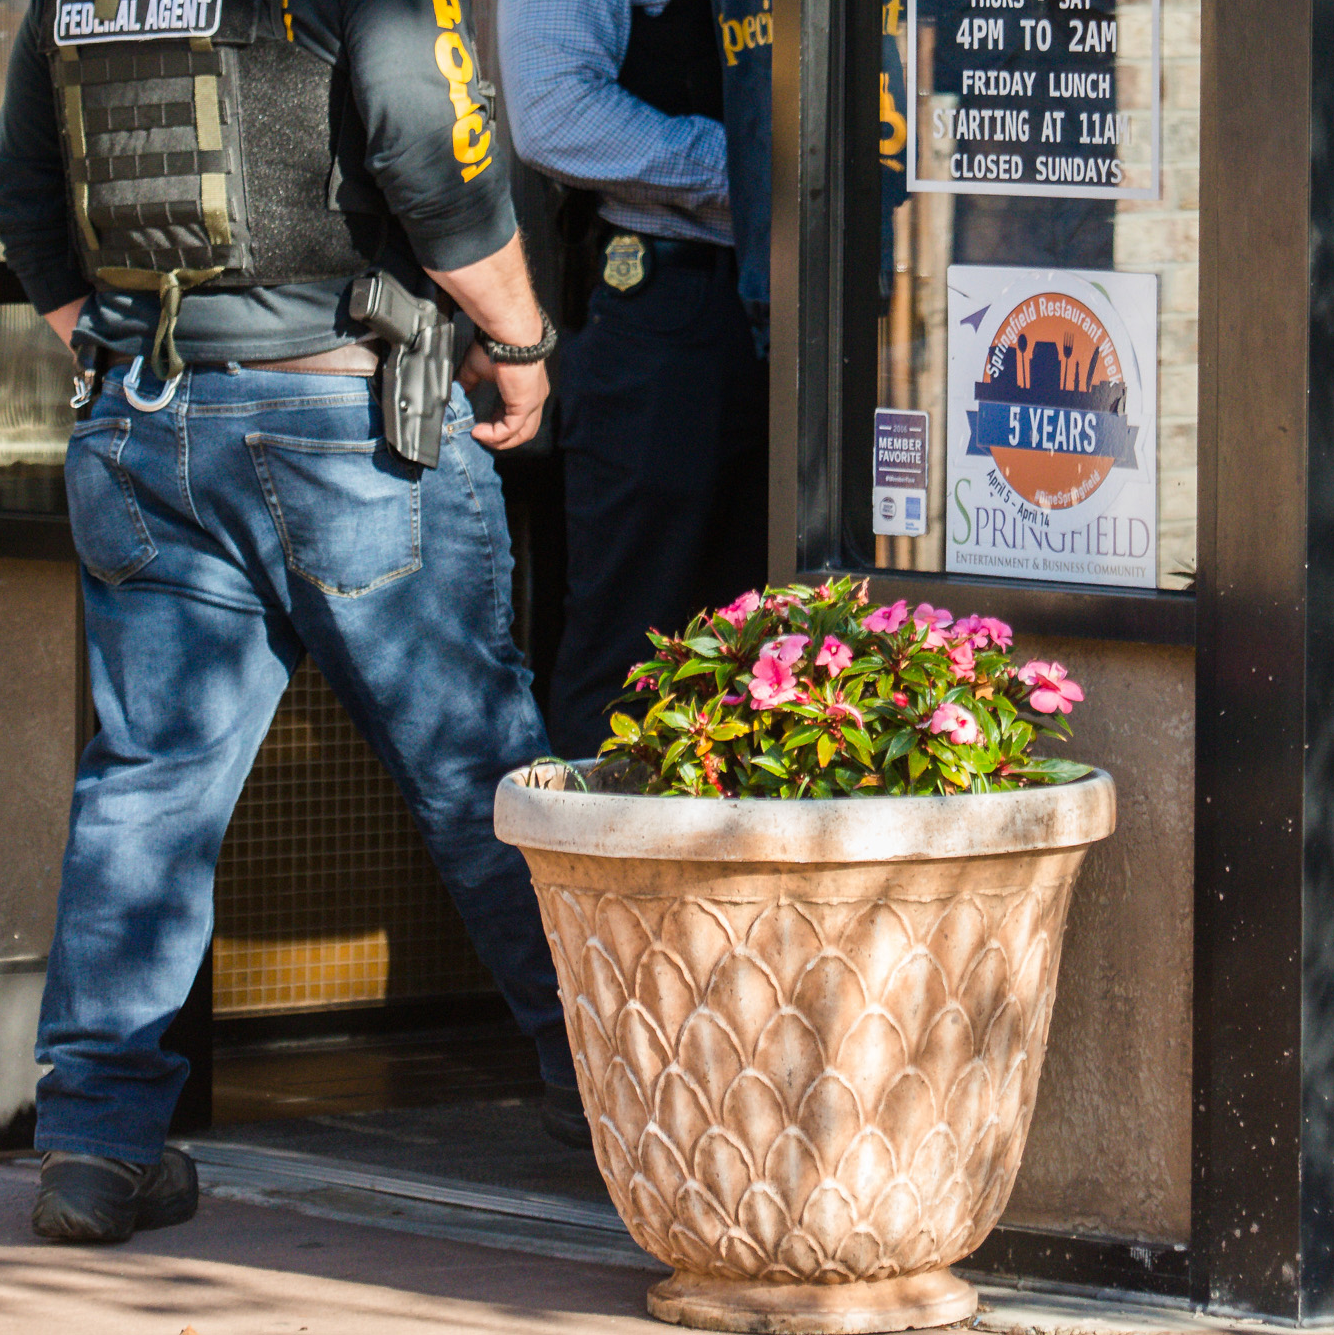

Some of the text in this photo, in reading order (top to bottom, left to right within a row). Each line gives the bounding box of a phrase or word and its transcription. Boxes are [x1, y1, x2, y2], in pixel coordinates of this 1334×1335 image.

[956, 18, 1117, 53] 4PM TO 2AM
[962, 70, 1110, 99] FRIDAY LUNCH
[932, 109, 1131, 145] STARTING AT 11AM
[950, 154, 1123, 184] CLOSED SUNDAYS
[986, 297, 1120, 387] Springfield Restaurant Week
[879, 437, 921, 451] MEMBER
[1008, 406, 1097, 453] 5 YEARS
[879, 450, 921, 464] FAVORITE
[987, 469, 1005, 498] April
[1003, 492, 1012, 504] 5
[1017, 502, 1038, 523] April
[1040, 512, 1050, 528] 14
[956, 551, 1147, 578] ENTERTAINMENT & BUSINESS COMMUNITY
